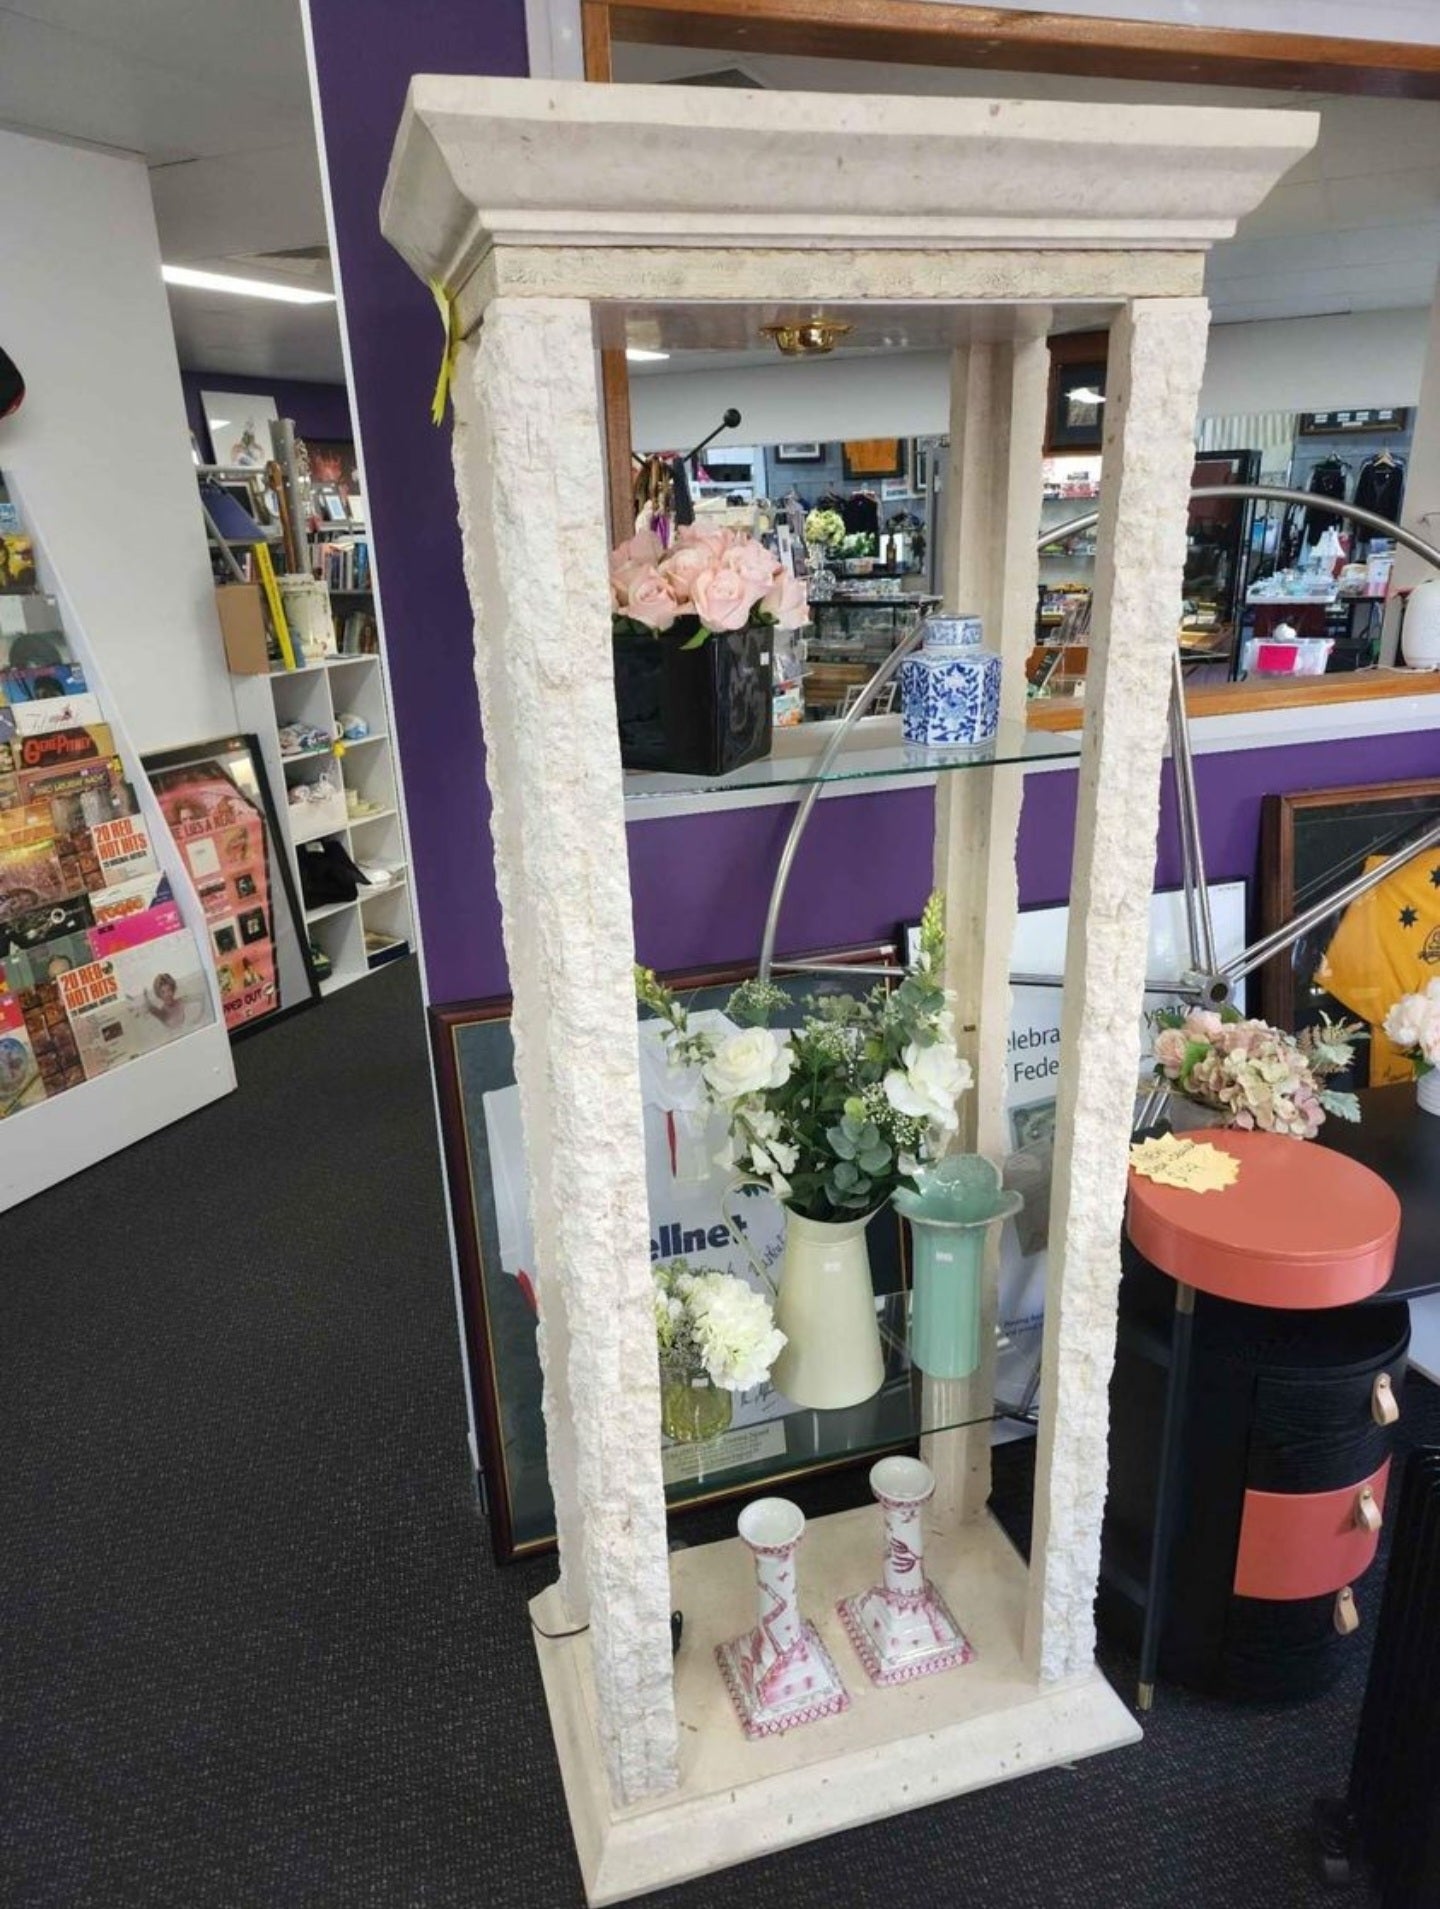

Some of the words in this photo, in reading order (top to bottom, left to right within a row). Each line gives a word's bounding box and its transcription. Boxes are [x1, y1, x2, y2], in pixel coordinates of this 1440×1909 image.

[93, 824, 111, 842] 20
[110, 818, 133, 838] RED
[98, 839, 120, 860] HOT
[121, 832, 148, 854] HITS
[60, 973, 79, 991] 20
[78, 963, 103, 984] RED
[66, 987, 90, 1009] HOT
[90, 975, 118, 999] HITS
[244, 988, 262, 1004] OUT
[1014, 1057, 1060, 1082] Fede
